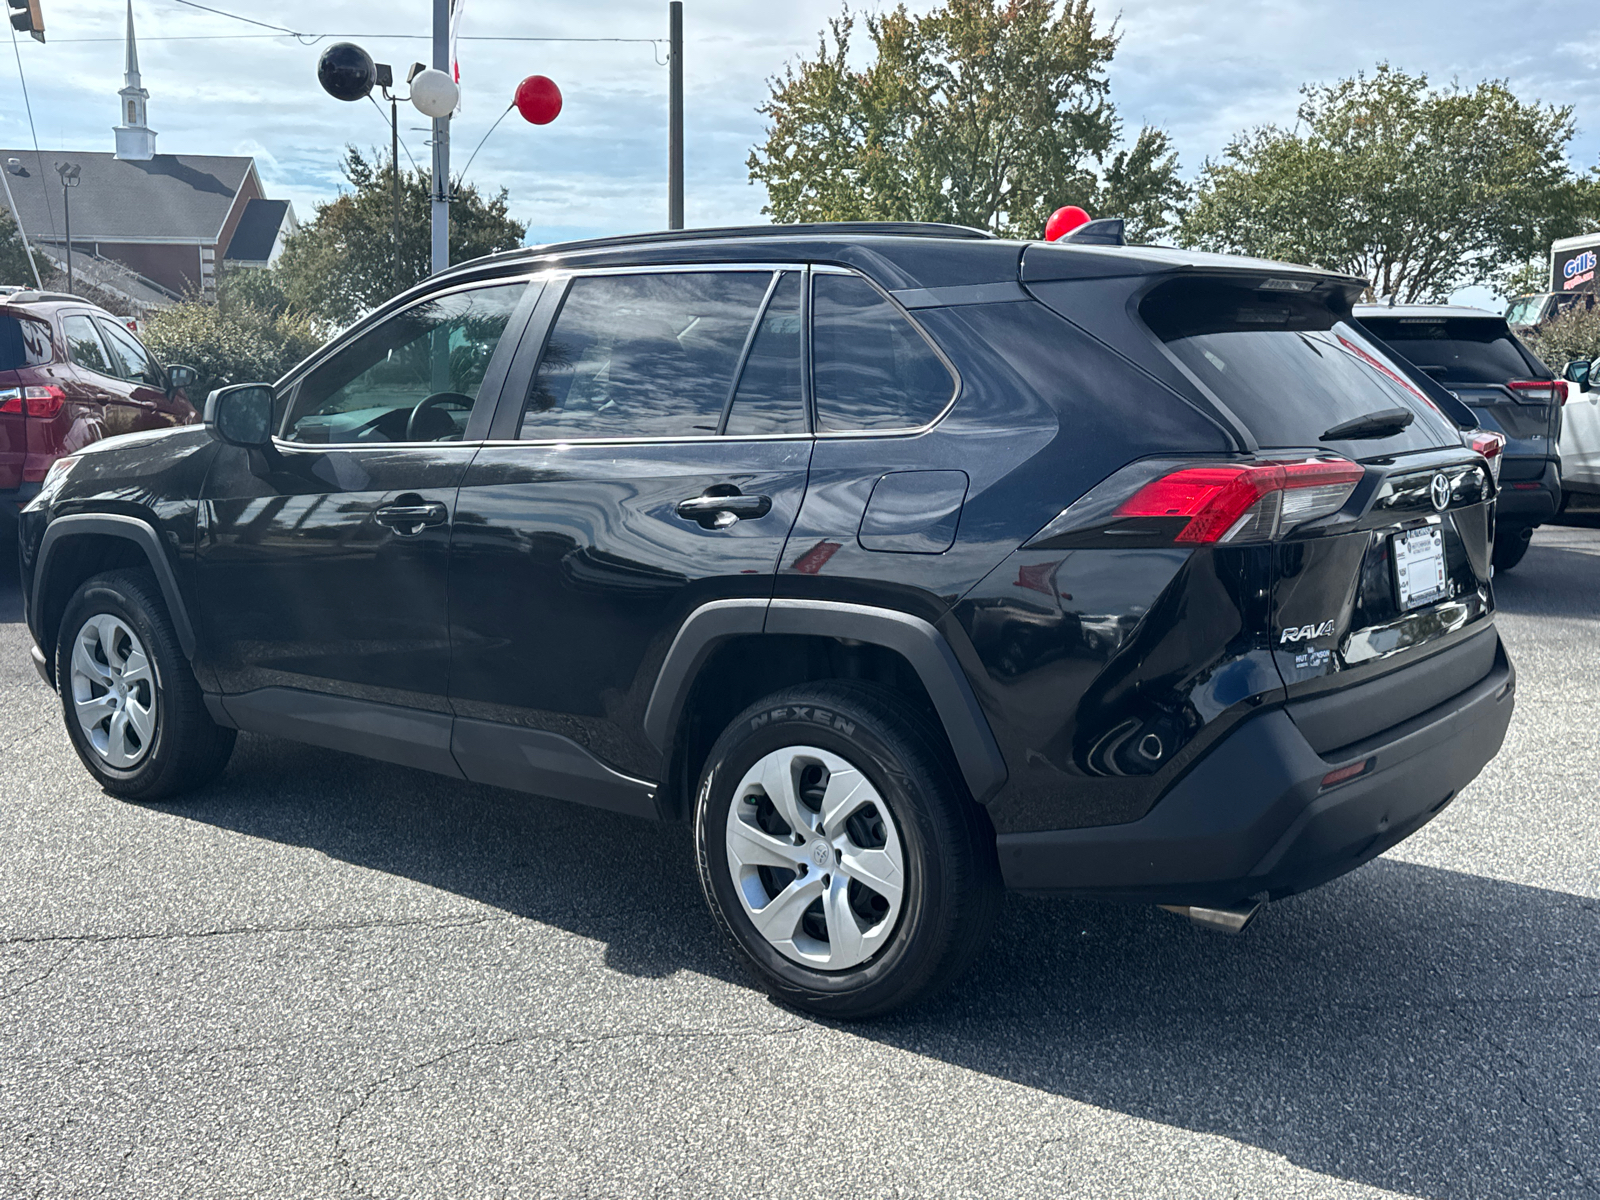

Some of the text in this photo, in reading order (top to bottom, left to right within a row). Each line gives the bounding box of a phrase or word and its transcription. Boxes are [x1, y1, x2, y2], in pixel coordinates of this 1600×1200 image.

[1564, 250, 1597, 279] Gill's
[1280, 619, 1335, 644] RAV4
[750, 706, 857, 737] NEXEN
